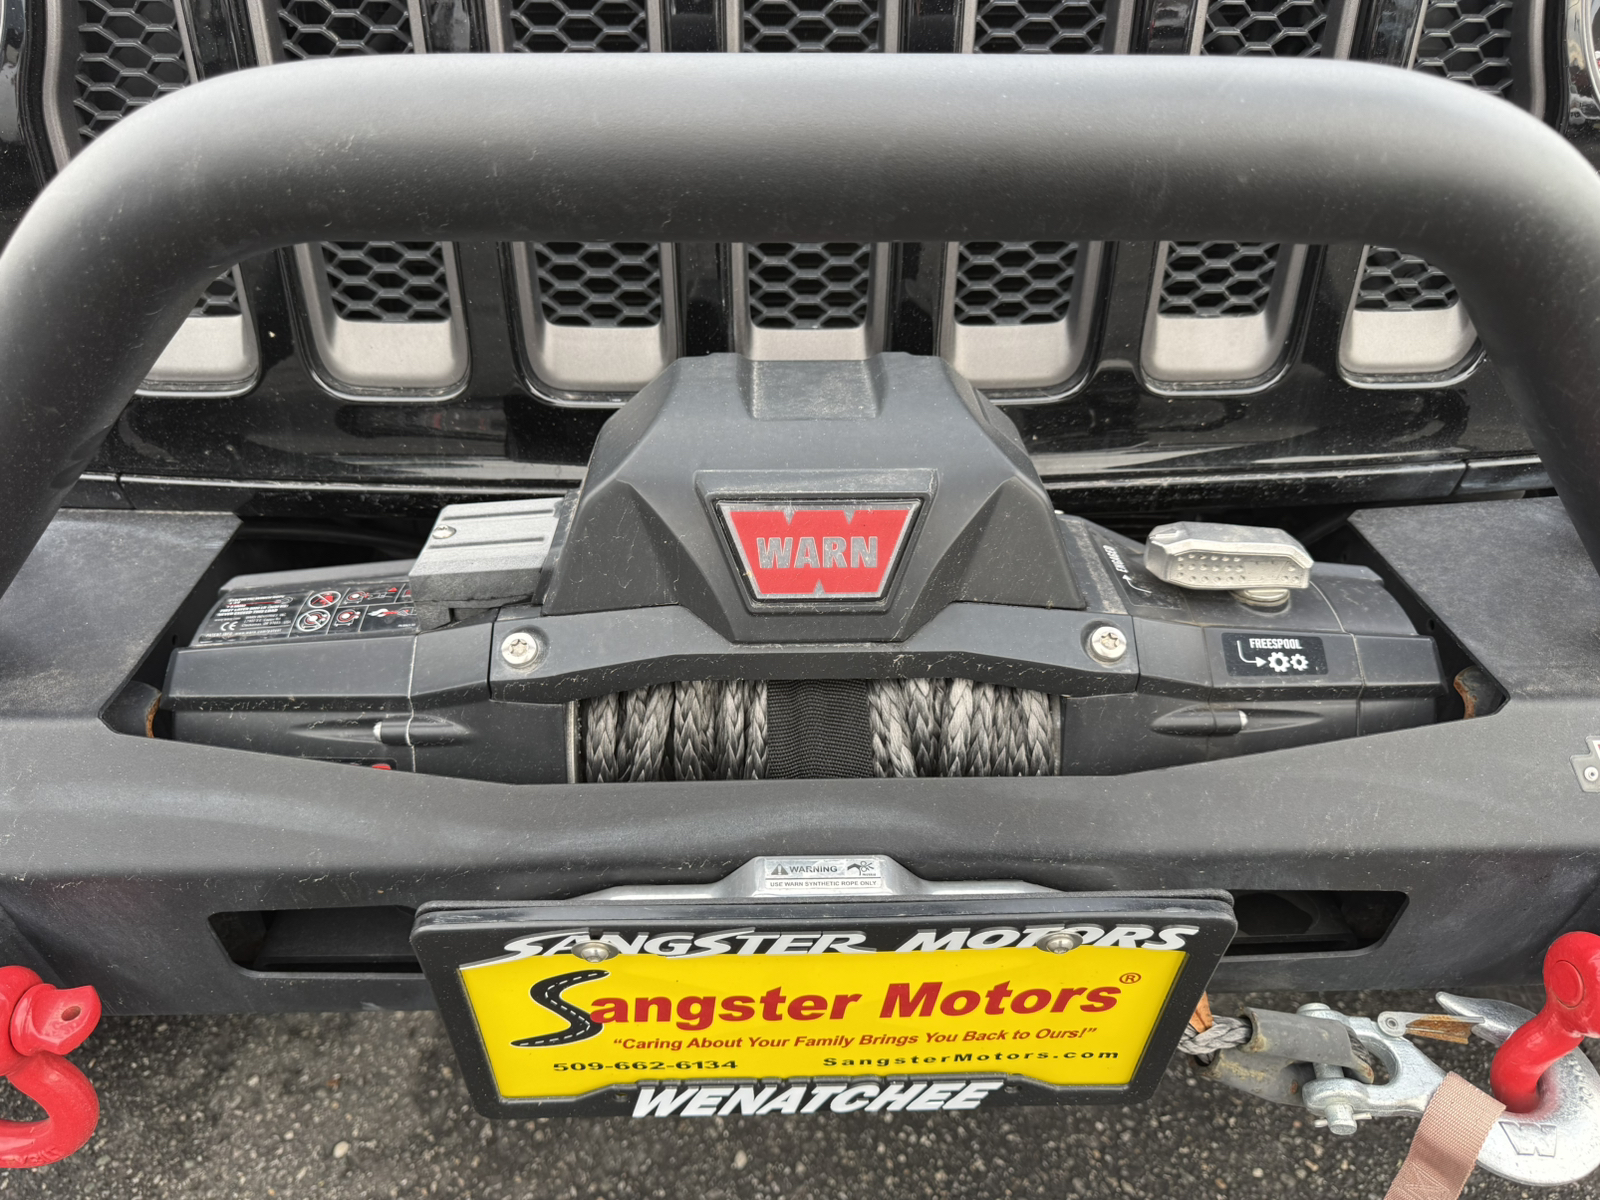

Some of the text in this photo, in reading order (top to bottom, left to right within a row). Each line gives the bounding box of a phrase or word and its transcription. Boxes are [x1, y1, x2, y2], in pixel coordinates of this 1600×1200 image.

[756, 536, 878, 569] WARN
[1249, 638, 1303, 649] FREESPOOL
[789, 865, 838, 873] WARNING
[510, 969, 863, 1047] Sangster
[687, 1037, 742, 1048] About
[748, 1036, 790, 1048] Your
[794, 1035, 855, 1048] Family
[859, 1033, 919, 1047] Brings
[925, 1032, 958, 1043] You
[962, 1029, 1008, 1042] Back
[1012, 1029, 1031, 1040] to
[553, 1060, 738, 1072] 509-662-6134
[823, 1051, 1119, 1067] SangsterMotors.com
[632, 1077, 1004, 1118] WENATCHEE
